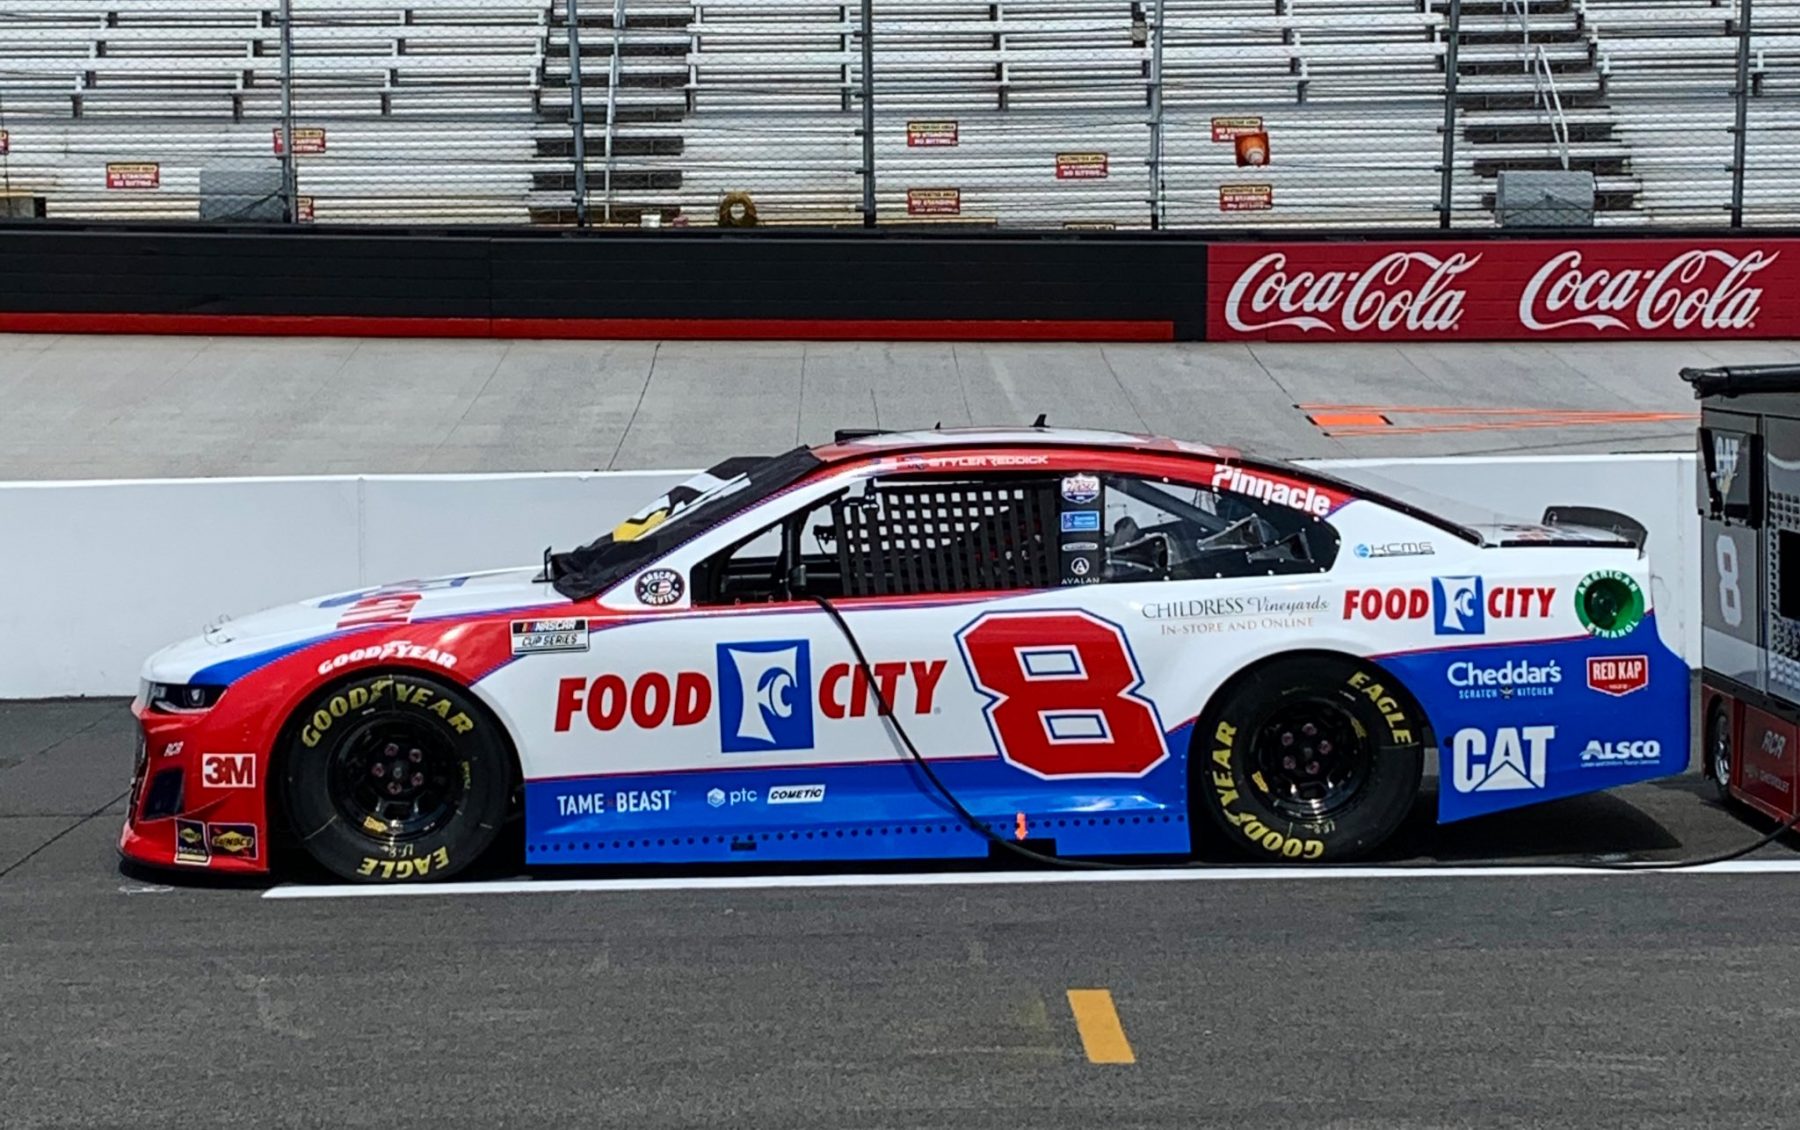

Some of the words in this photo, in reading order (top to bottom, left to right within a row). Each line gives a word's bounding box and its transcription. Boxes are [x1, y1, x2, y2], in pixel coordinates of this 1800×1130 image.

[1225, 252, 1482, 332] Coca-Cola
[1519, 250, 1780, 331] Coca-Cola
[988, 455, 1048, 467] REDDICK
[1211, 464, 1331, 516] Pinnacle
[1578, 570, 1639, 595] AMERICAN
[1716, 534, 1742, 627] 8
[1141, 597, 1244, 619] CHILDRESS
[1247, 595, 1328, 616] Vineyards
[1343, 588, 1430, 621] FOOD
[1487, 587, 1556, 619] CITY
[534, 620, 577, 632] NASCAR
[1587, 621, 1640, 639] ETHANOL
[317, 639, 458, 675] GOODYEAR
[1592, 661, 1617, 681] RED
[1618, 660, 1643, 680] KAP
[1446, 659, 1562, 687] Cheddar's
[554, 671, 712, 733] FOOD
[818, 660, 948, 719] CITY
[953, 607, 1171, 780] 8
[1347, 671, 1413, 745] EAGLE
[302, 679, 474, 748] GOODYEAR
[1452, 725, 1555, 793] CAT
[1580, 740, 1661, 761] ALSCO
[205, 756, 253, 786] 3M
[557, 793, 605, 816] TAME
[615, 790, 672, 813] BEAST
[729, 787, 758, 806] ptc
[770, 788, 823, 801] COMETIC
[356, 846, 450, 879] EAGLE
